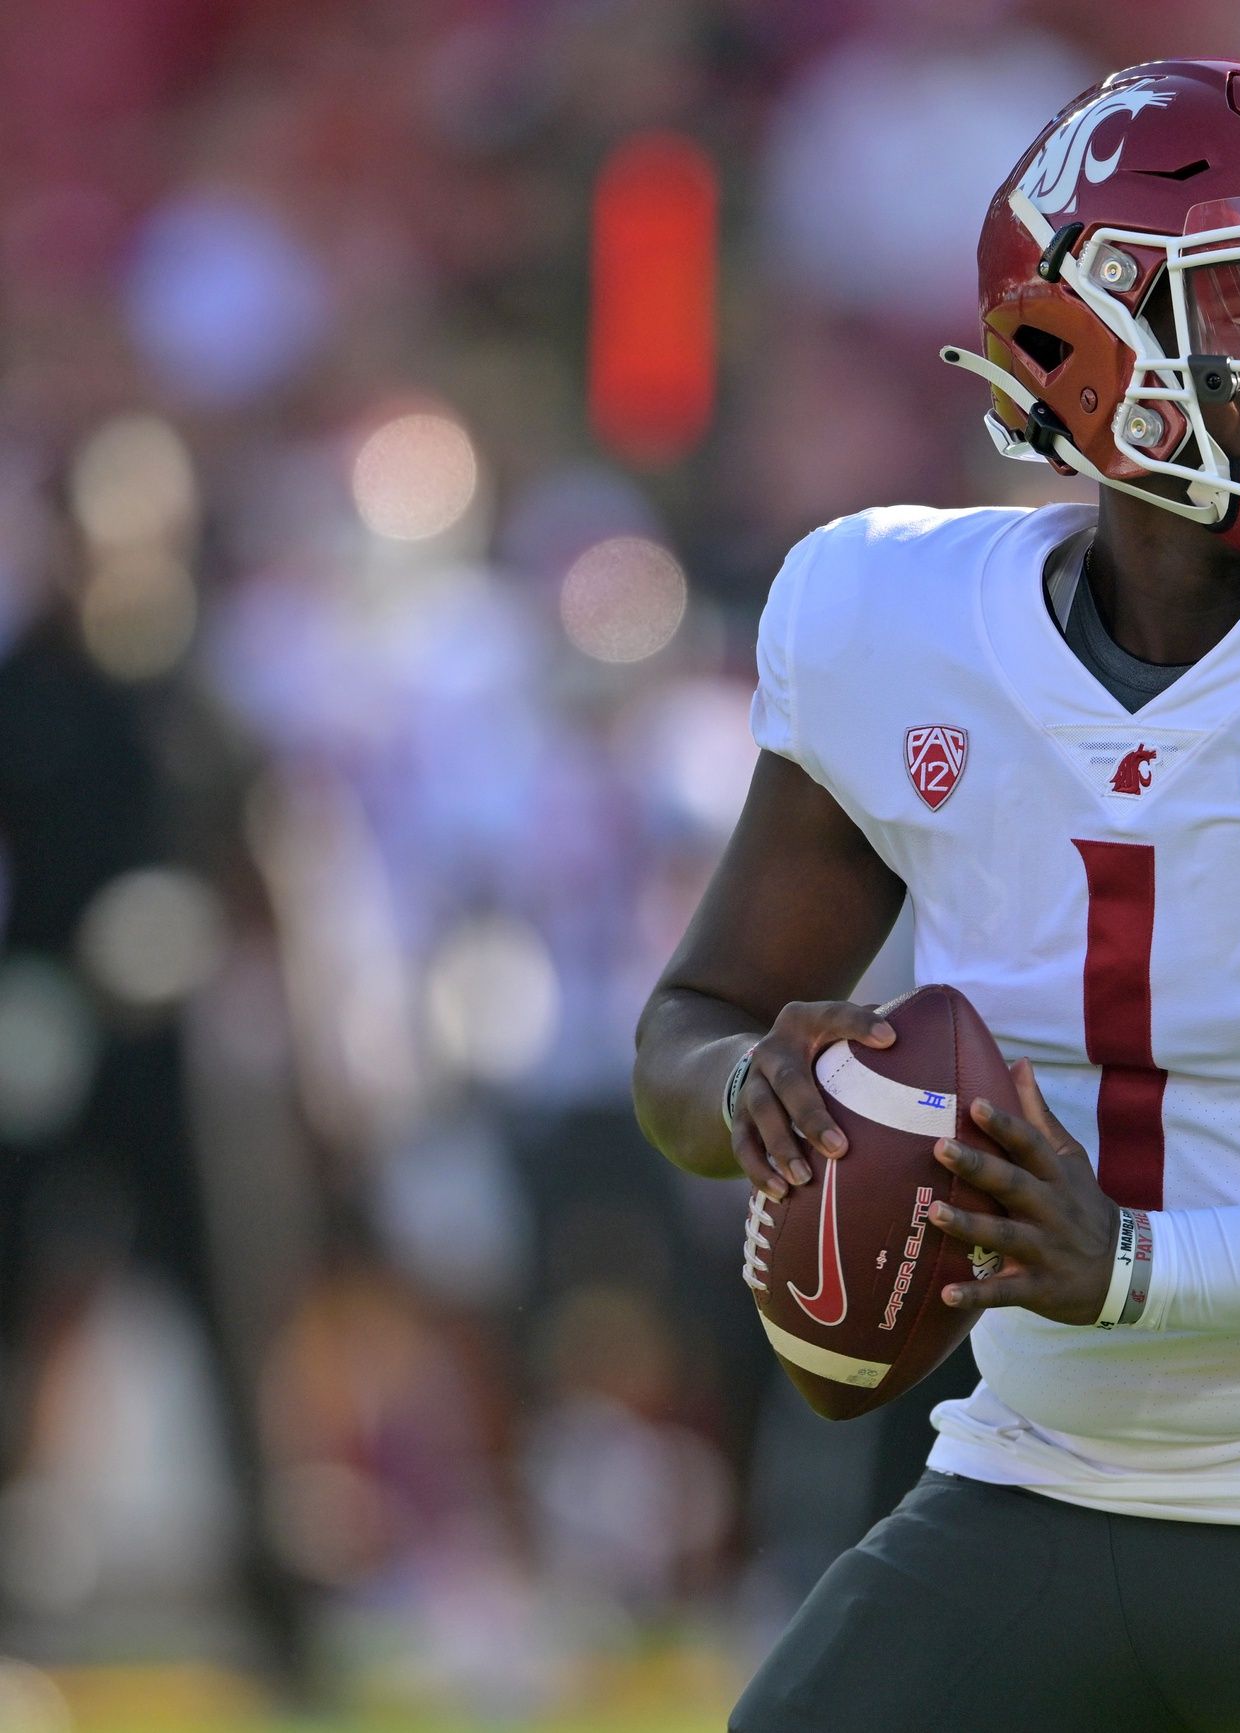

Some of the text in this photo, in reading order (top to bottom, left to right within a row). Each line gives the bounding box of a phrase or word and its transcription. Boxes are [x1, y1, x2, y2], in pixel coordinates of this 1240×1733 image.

[907, 727, 964, 778] PAC
[919, 761, 949, 792] 12
[1070, 838, 1168, 1212] 1
[1120, 1217, 1135, 1252] MAMBA
[1135, 1234, 1153, 1262] PAY
[878, 1186, 933, 1331] VAPOR ELITE
